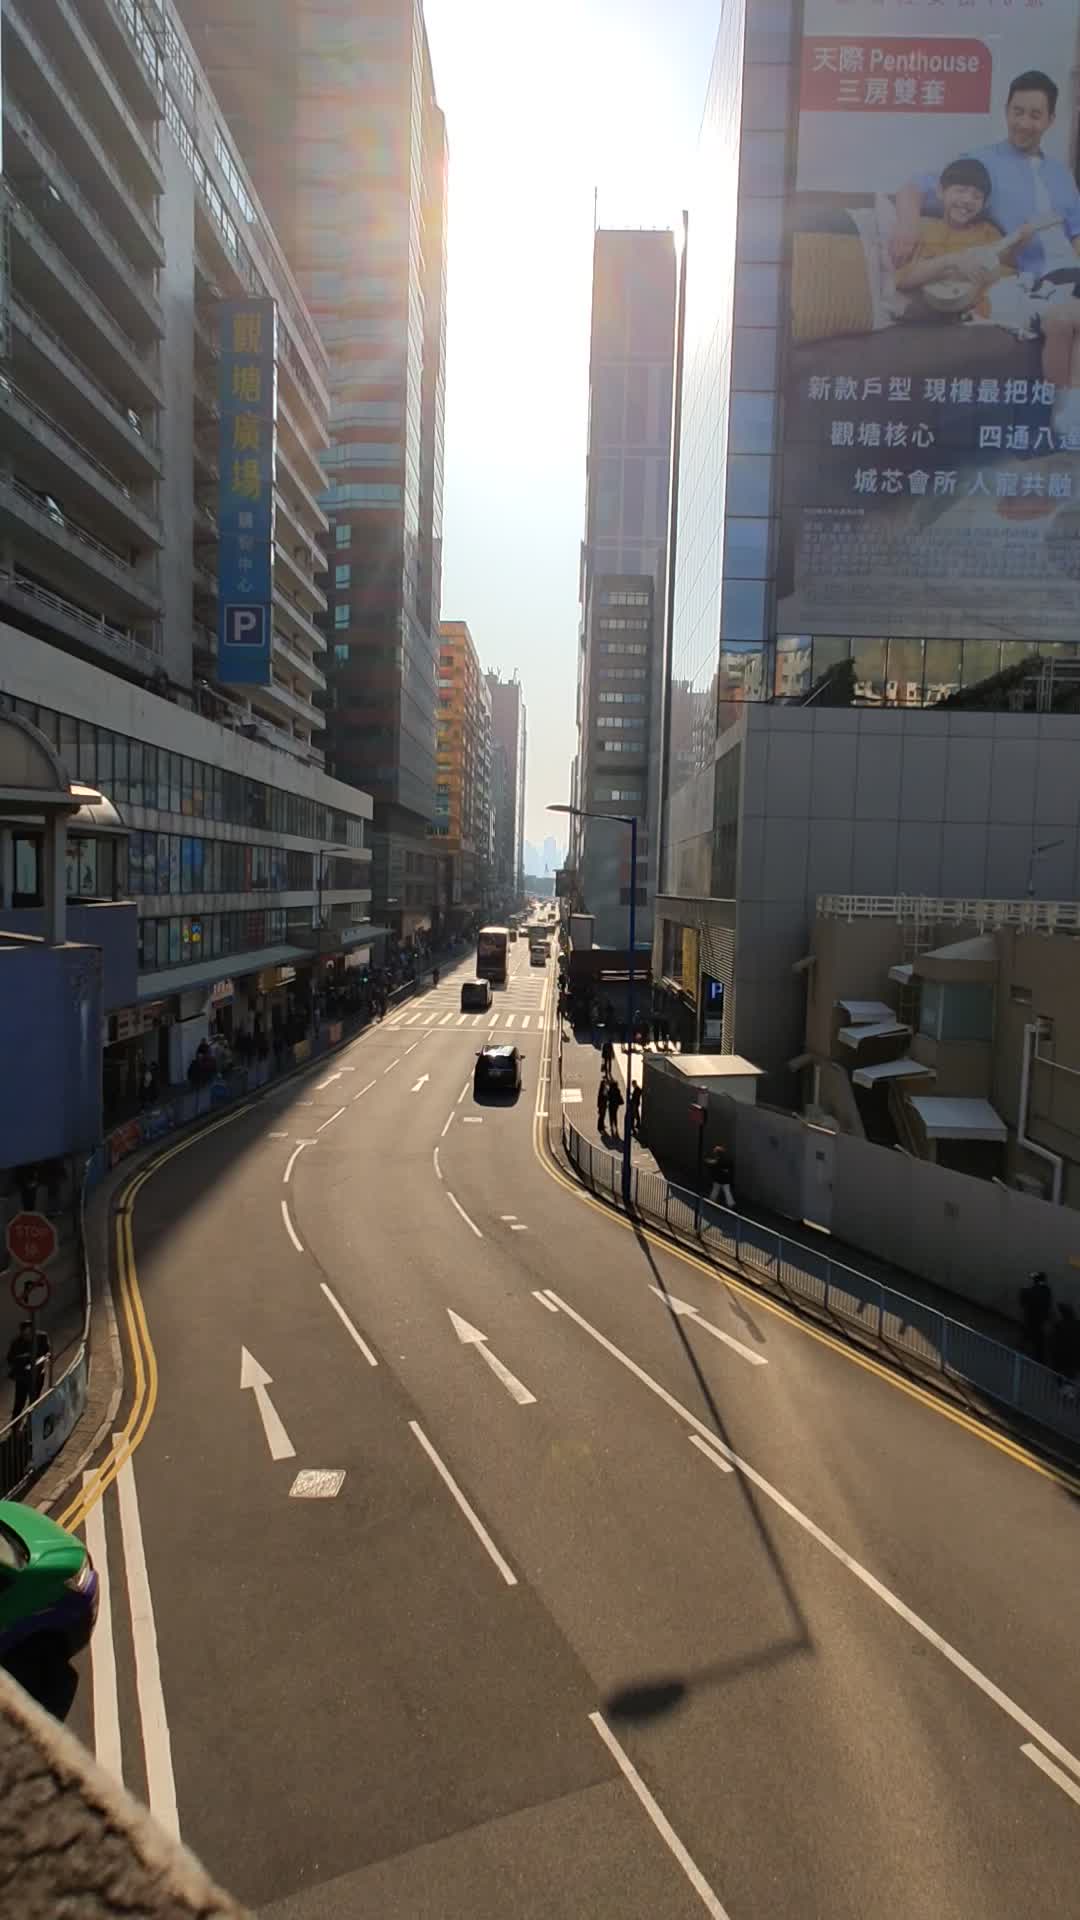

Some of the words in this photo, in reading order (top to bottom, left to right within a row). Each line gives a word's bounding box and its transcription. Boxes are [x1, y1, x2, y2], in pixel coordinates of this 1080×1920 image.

[812, 46, 864, 72] 天際
[870, 48, 980, 73] Penthouse
[830, 420, 936, 449] 觀塘核心
[853, 467, 958, 495] 城芯會所
[233, 611, 257, 641] P
[711, 982, 723, 999] P
